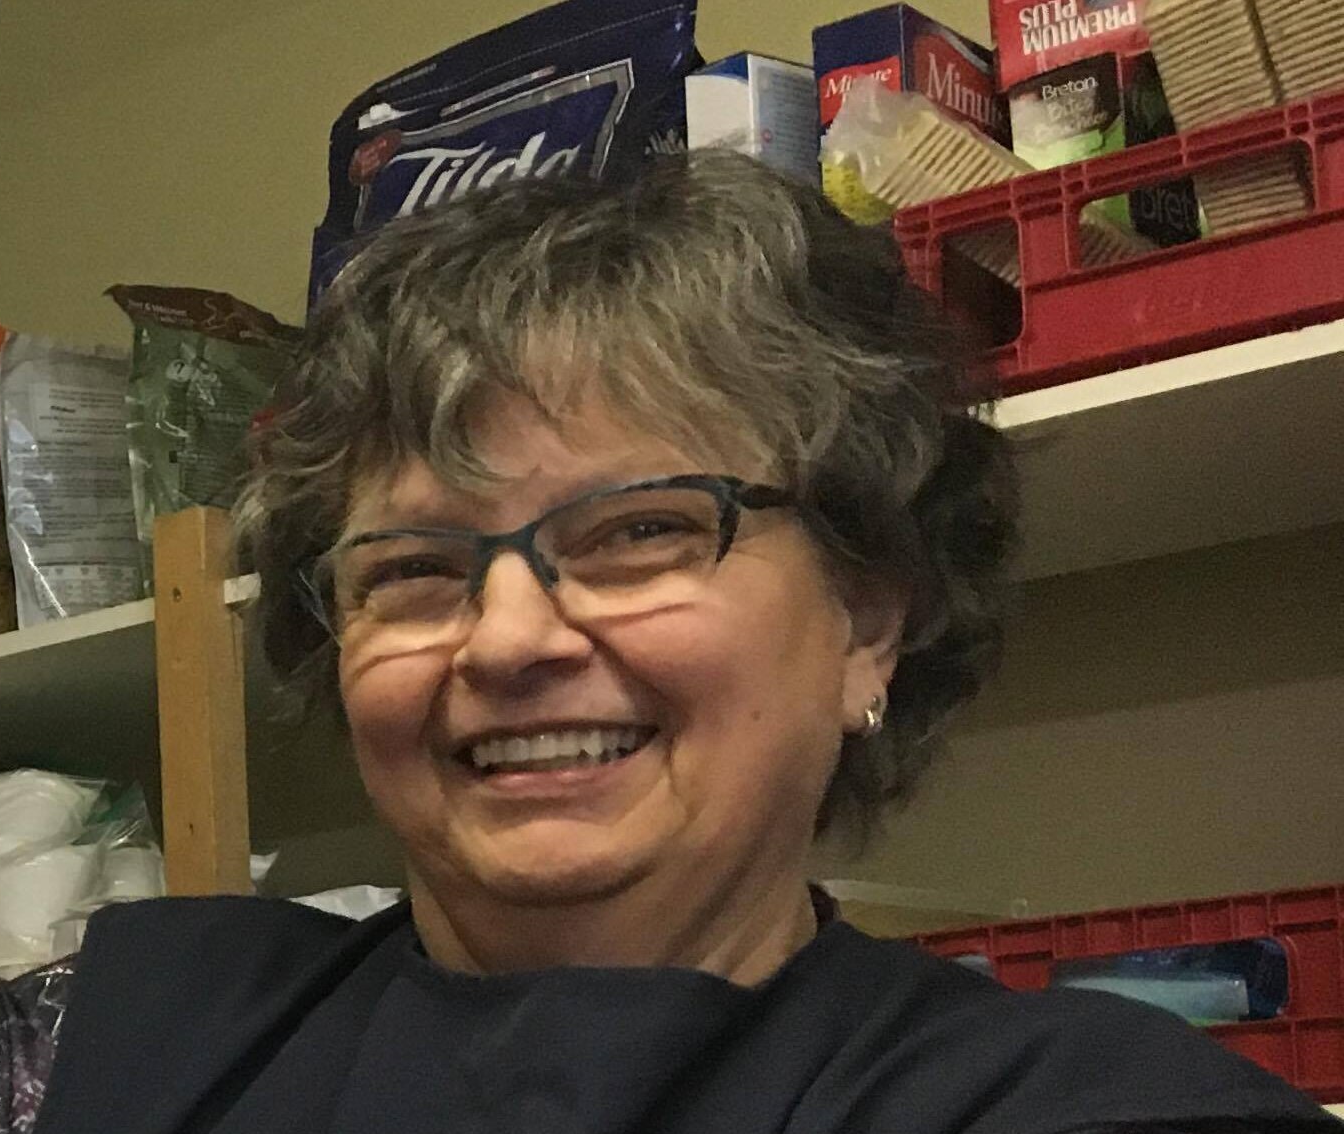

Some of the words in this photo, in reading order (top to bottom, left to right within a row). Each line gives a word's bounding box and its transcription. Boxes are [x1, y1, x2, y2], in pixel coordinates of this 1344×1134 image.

[1019, 0, 1077, 30] PLUS
[1022, 2, 1137, 55] PREMIUM
[825, 67, 892, 98] Mite
[927, 52, 997, 125] Minu
[1042, 76, 1097, 101] Breton
